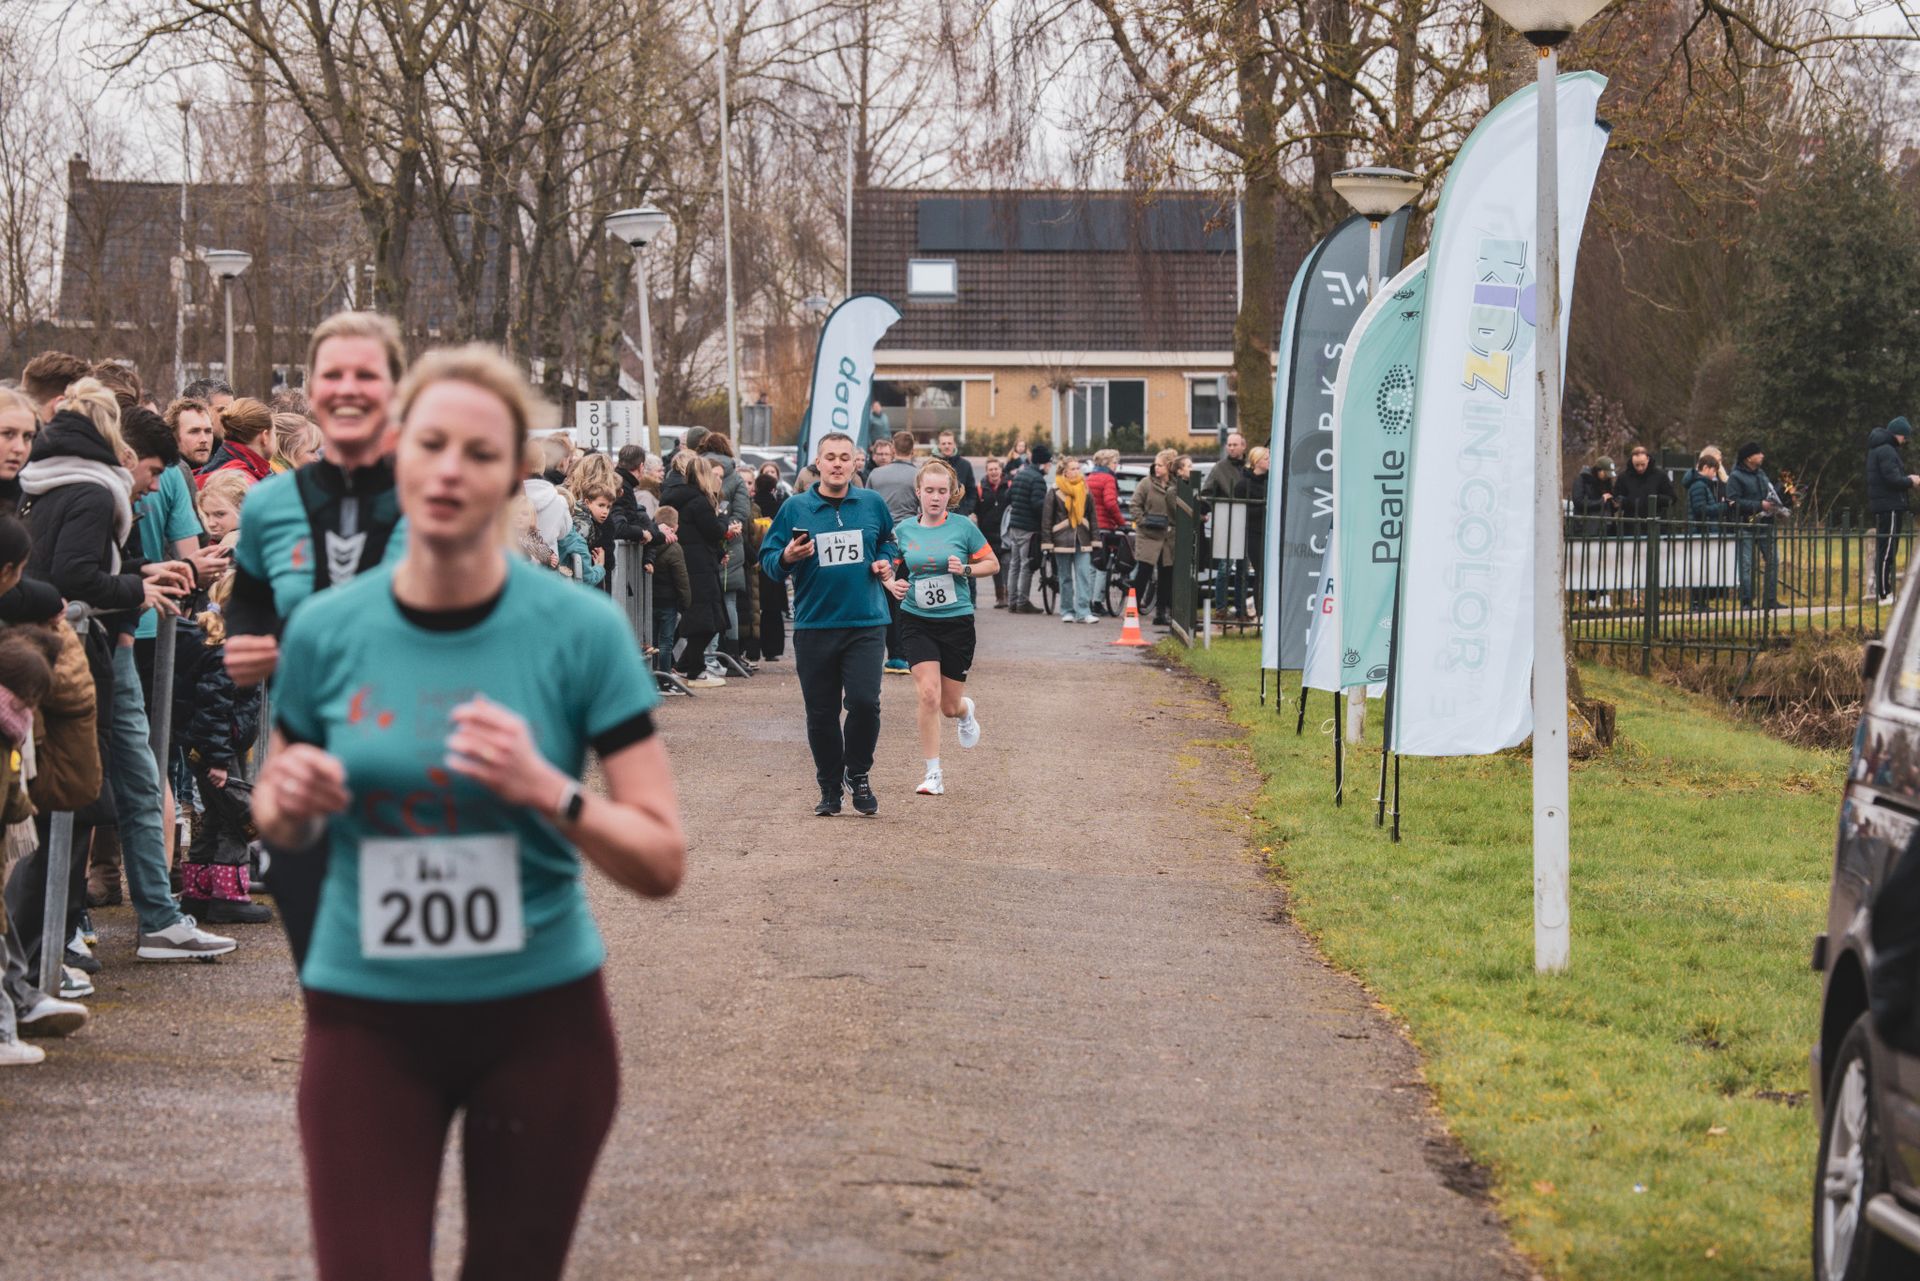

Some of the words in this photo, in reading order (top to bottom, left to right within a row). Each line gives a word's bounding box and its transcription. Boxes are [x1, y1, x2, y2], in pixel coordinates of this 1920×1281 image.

[1462, 238, 1528, 400] KIDZ
[1372, 449, 1405, 564] Pearle
[824, 544, 859, 563] 175
[925, 588, 947, 606] 38
[380, 885, 500, 946] 200
